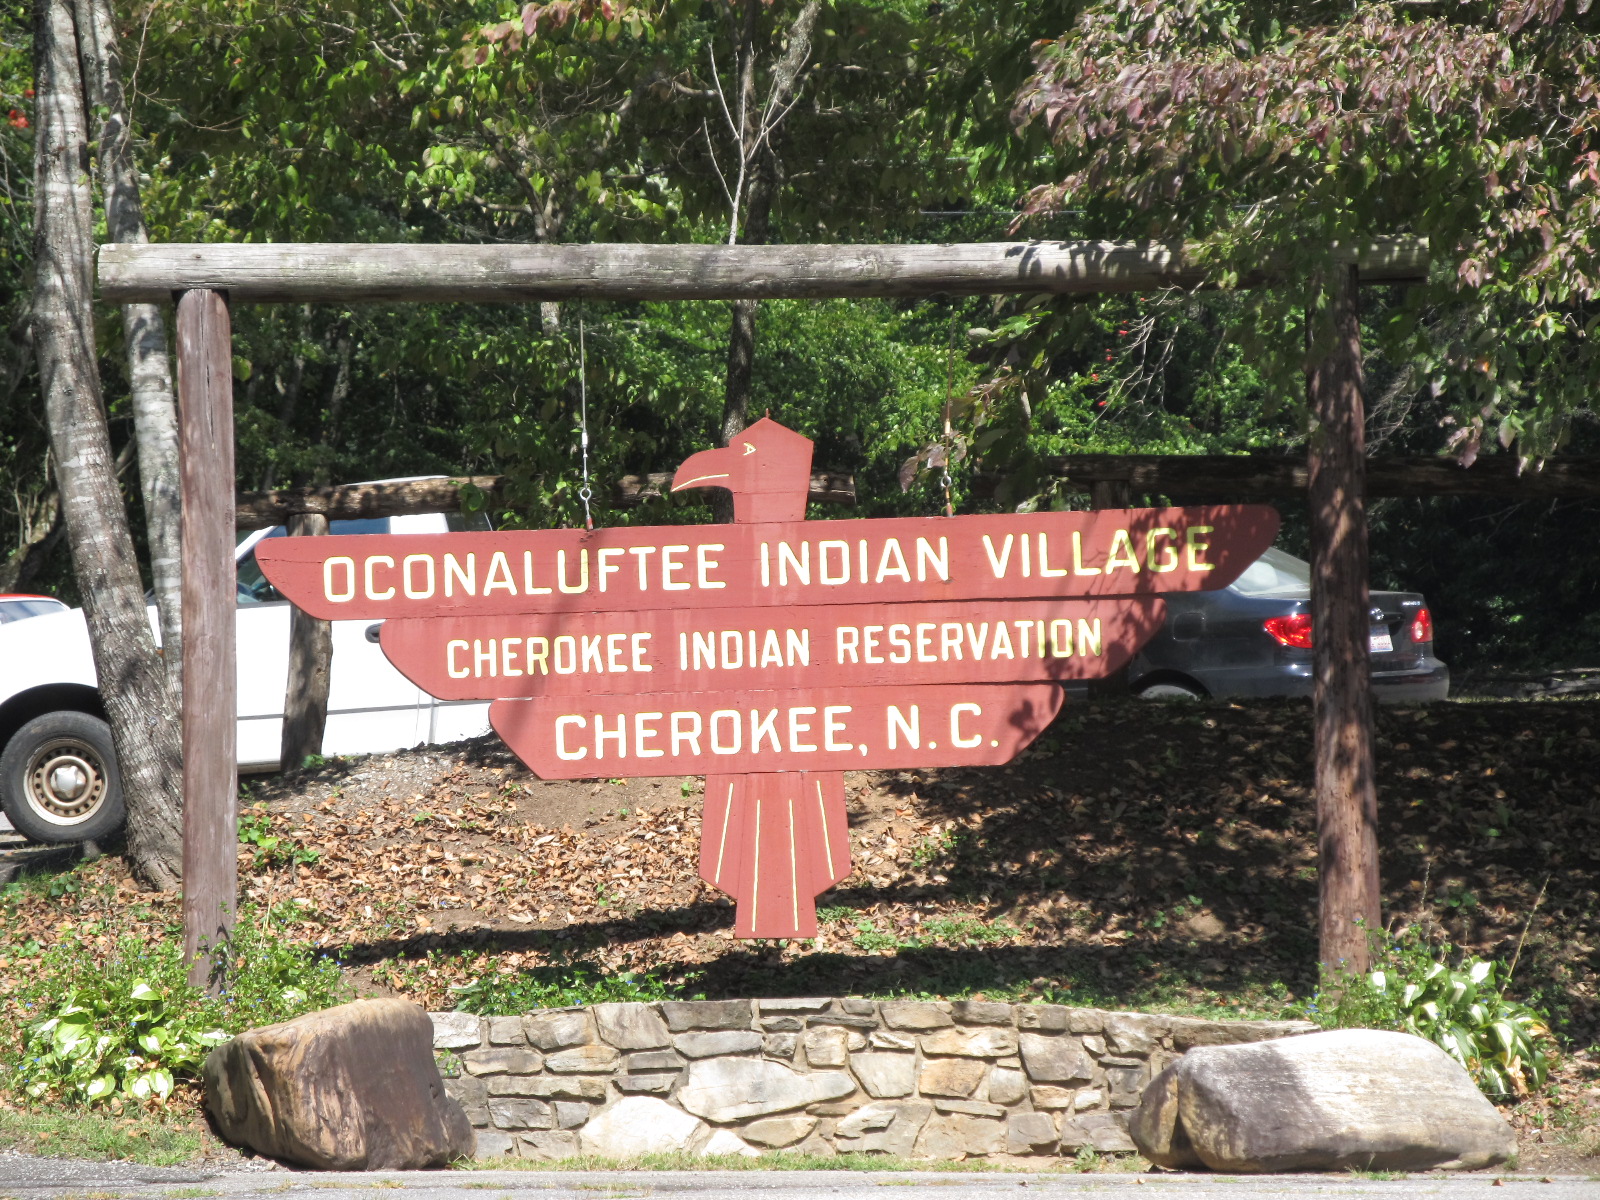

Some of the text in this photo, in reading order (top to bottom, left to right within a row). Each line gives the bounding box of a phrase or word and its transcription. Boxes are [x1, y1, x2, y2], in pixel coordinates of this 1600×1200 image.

[323, 525, 1216, 603] OCONALUFTEE INDIAN VILLAGE
[446, 618, 1102, 679] CHEROKEE INDIAN RESERVATION
[555, 705, 868, 761] CHEROKEE,
